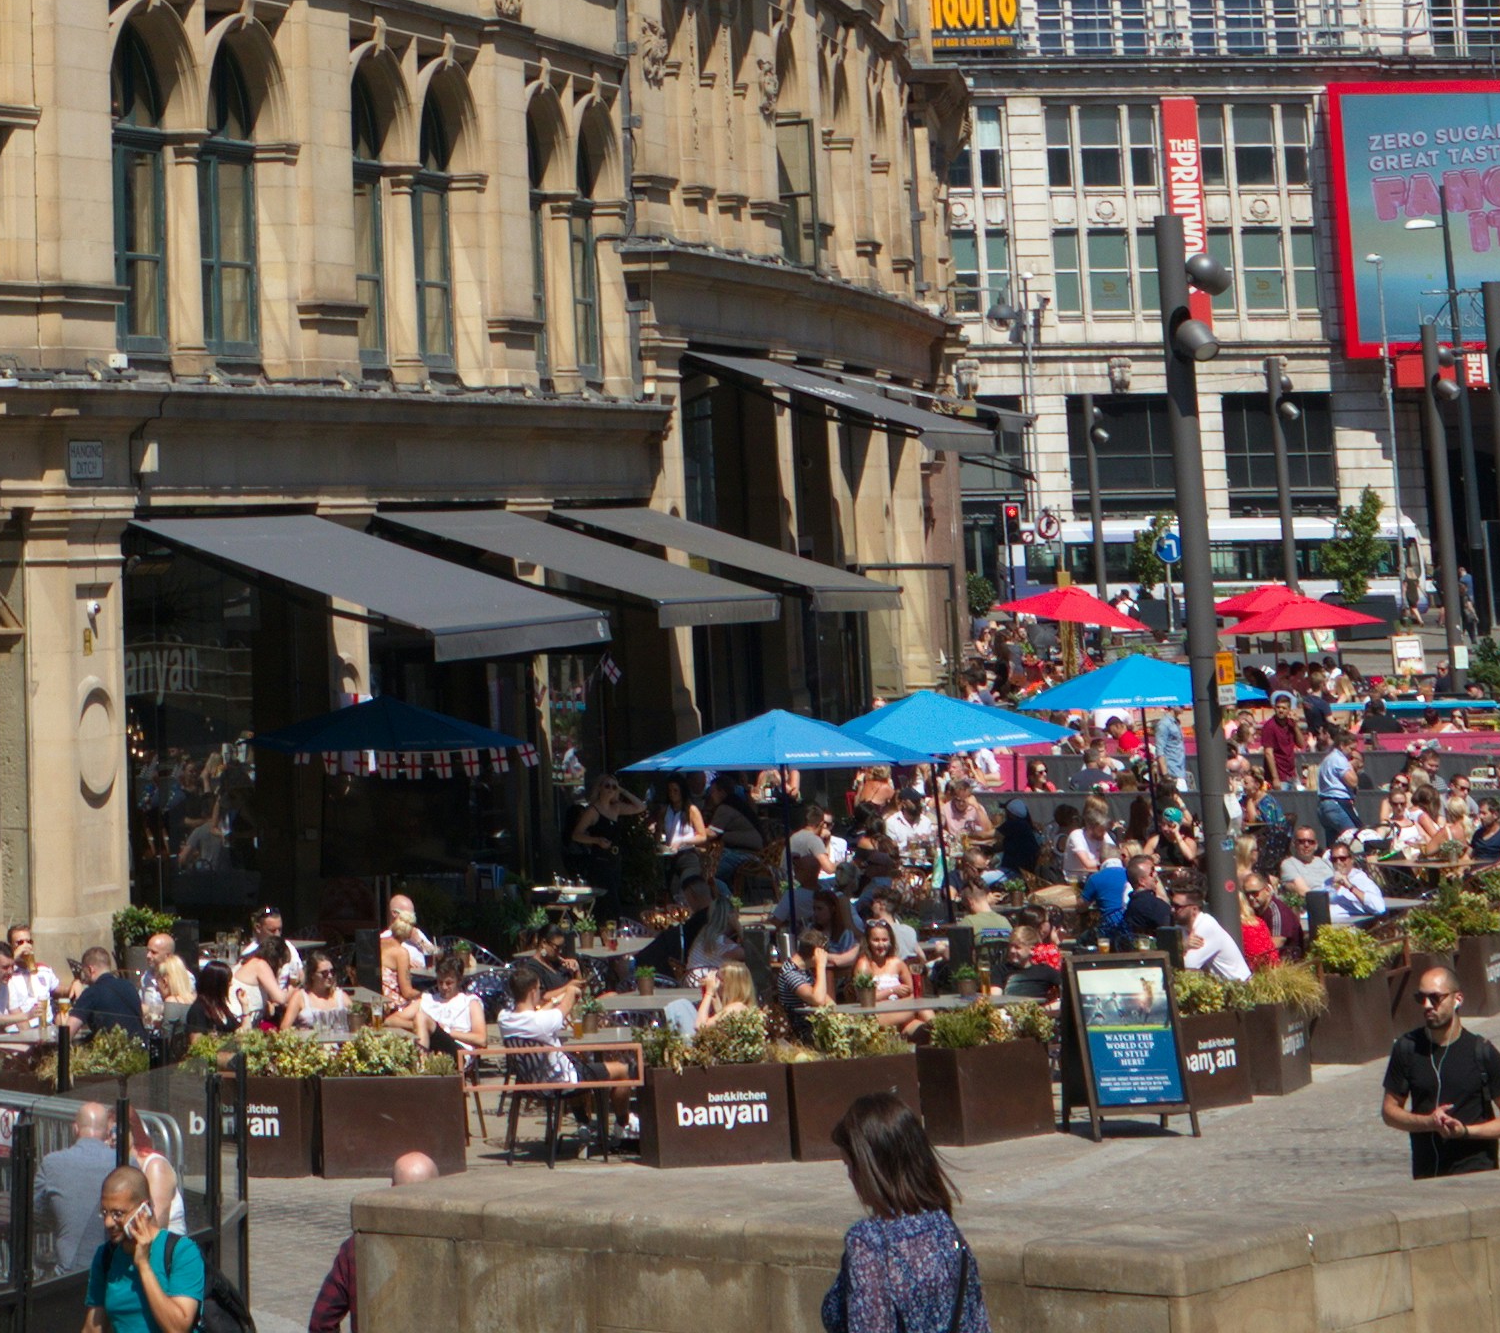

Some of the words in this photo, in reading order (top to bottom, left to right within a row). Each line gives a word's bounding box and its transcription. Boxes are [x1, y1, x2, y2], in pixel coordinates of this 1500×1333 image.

[1169, 139, 1196, 152] THE
[1369, 131, 1428, 151] ZERO
[1369, 150, 1440, 172] GREAT
[1137, 1033, 1153, 1041] THE
[1106, 1042, 1136, 1050] WORLD
[1125, 1050, 1149, 1058] STYLE
[1121, 1058, 1145, 1066] HERE!
[708, 1091, 767, 1102] bar&kitchen
[677, 1102, 769, 1129] banyan
[189, 1111, 280, 1137] bnan
